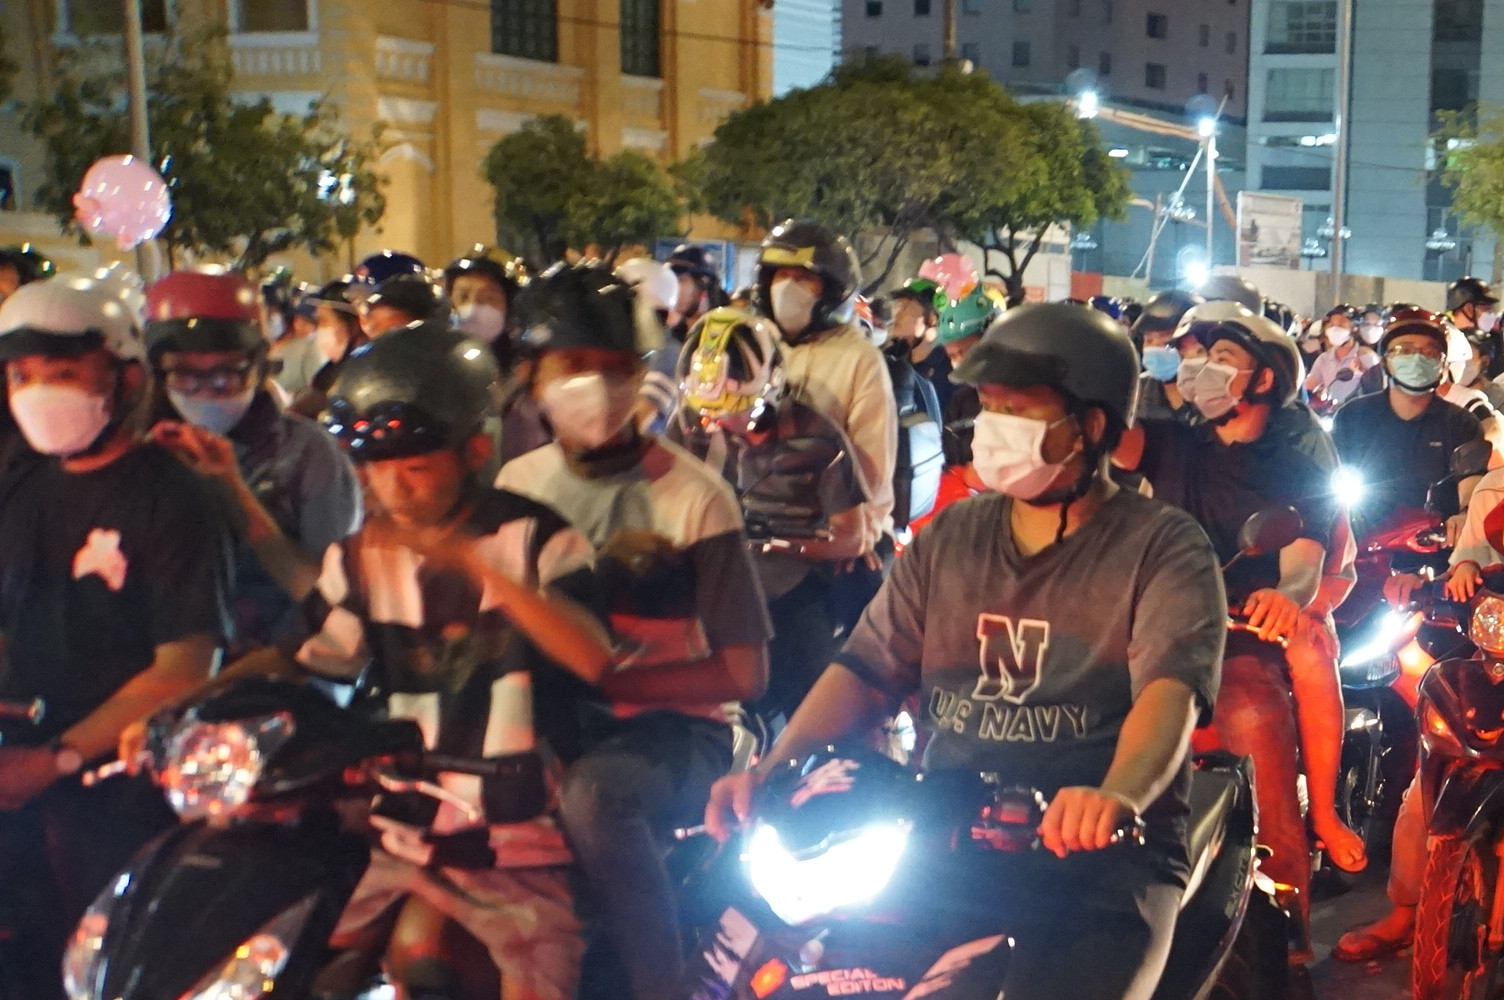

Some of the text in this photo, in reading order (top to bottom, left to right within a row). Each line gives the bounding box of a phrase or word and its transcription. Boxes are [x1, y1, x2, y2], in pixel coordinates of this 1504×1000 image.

[971, 612, 1050, 705] N
[978, 702, 1087, 742] NAVY
[790, 967, 879, 990] SPECIAL
